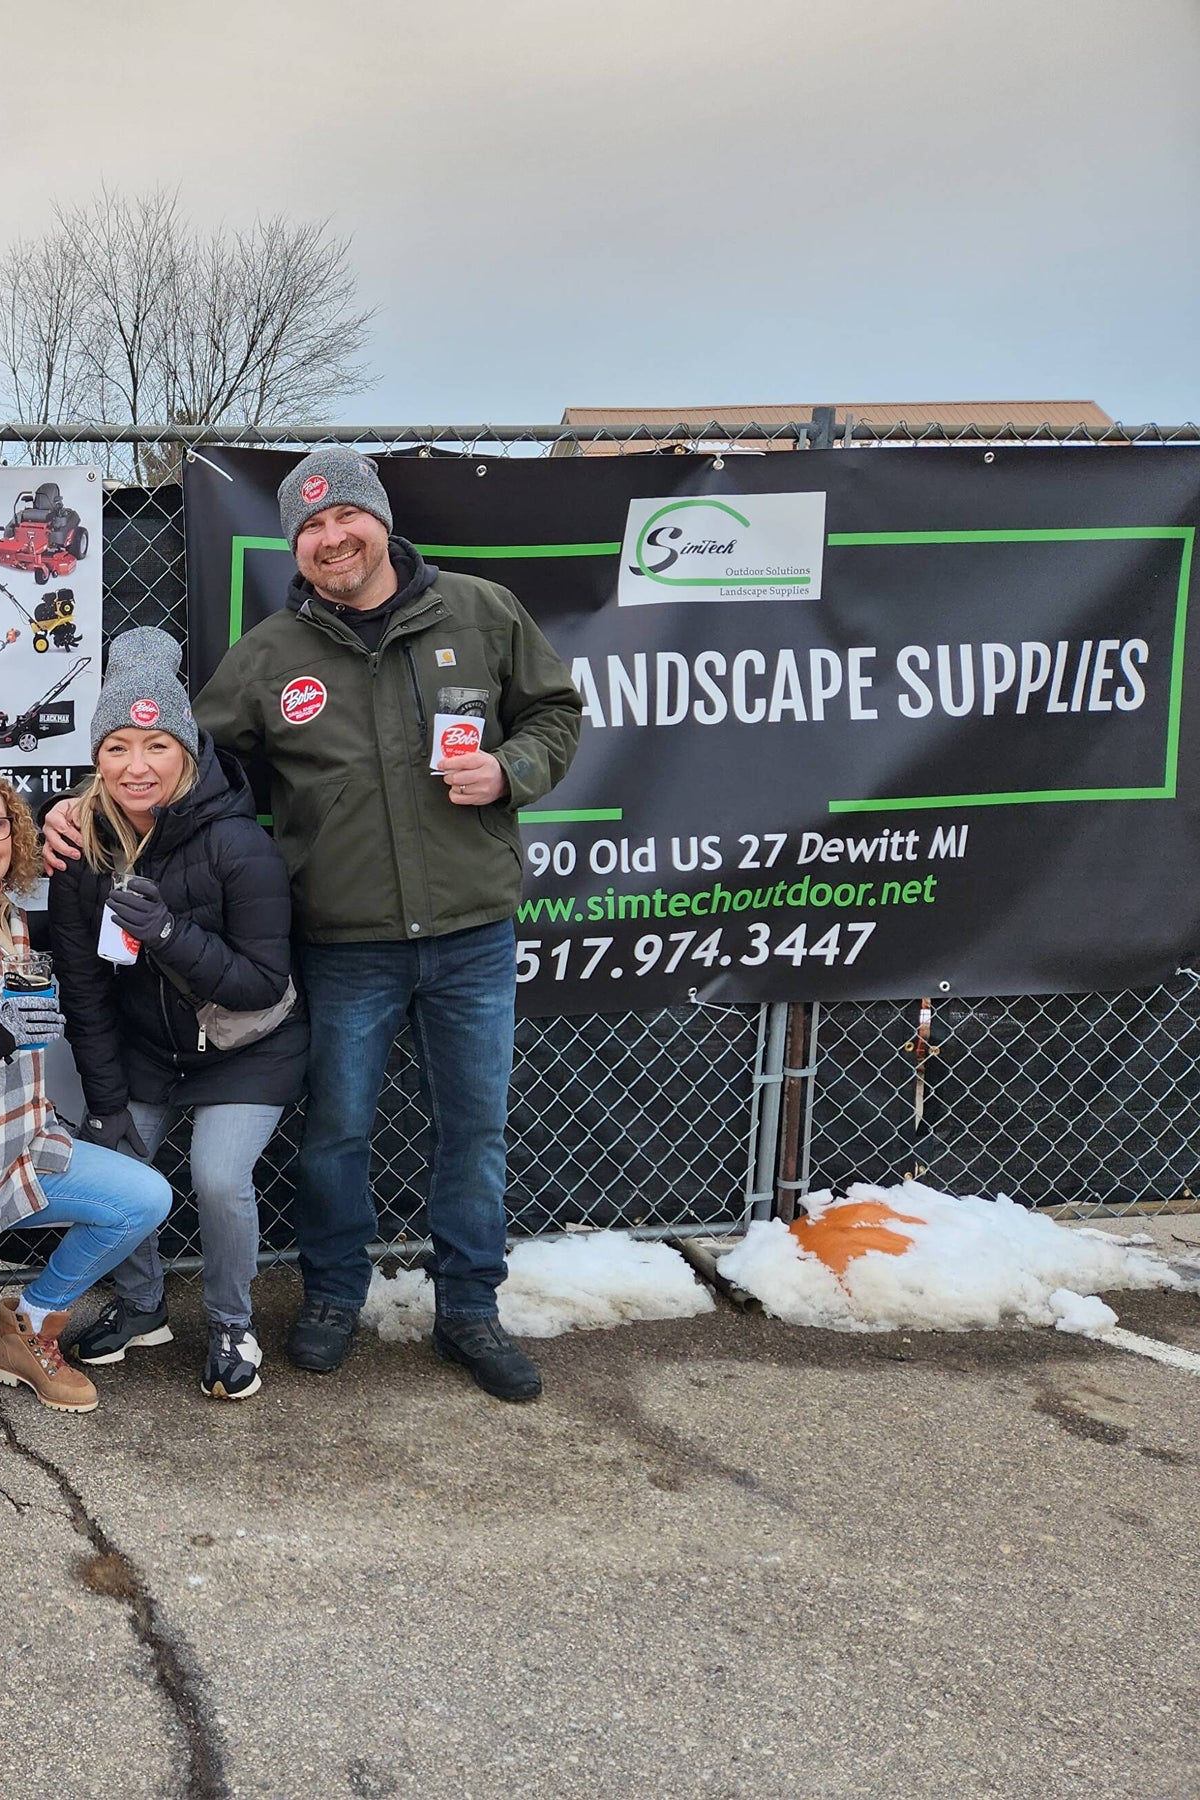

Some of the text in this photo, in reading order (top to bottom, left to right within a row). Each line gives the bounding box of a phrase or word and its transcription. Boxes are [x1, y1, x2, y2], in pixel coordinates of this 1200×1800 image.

[629, 526, 738, 576] SimTech
[725, 566, 811, 577] Outdoor Solutions
[719, 586, 810, 597] Landscape Supplies
[283, 685, 324, 712] Bob's
[571, 638, 1148, 728] ANDSCAPE SUPPLIES
[41, 768, 71, 793] it!
[589, 837, 656, 875] Old
[671, 836, 723, 871] US
[737, 833, 788, 869] 27
[797, 829, 919, 866] Dewitt
[928, 824, 969, 860] MI
[516, 922, 877, 983] 517.974.3447
